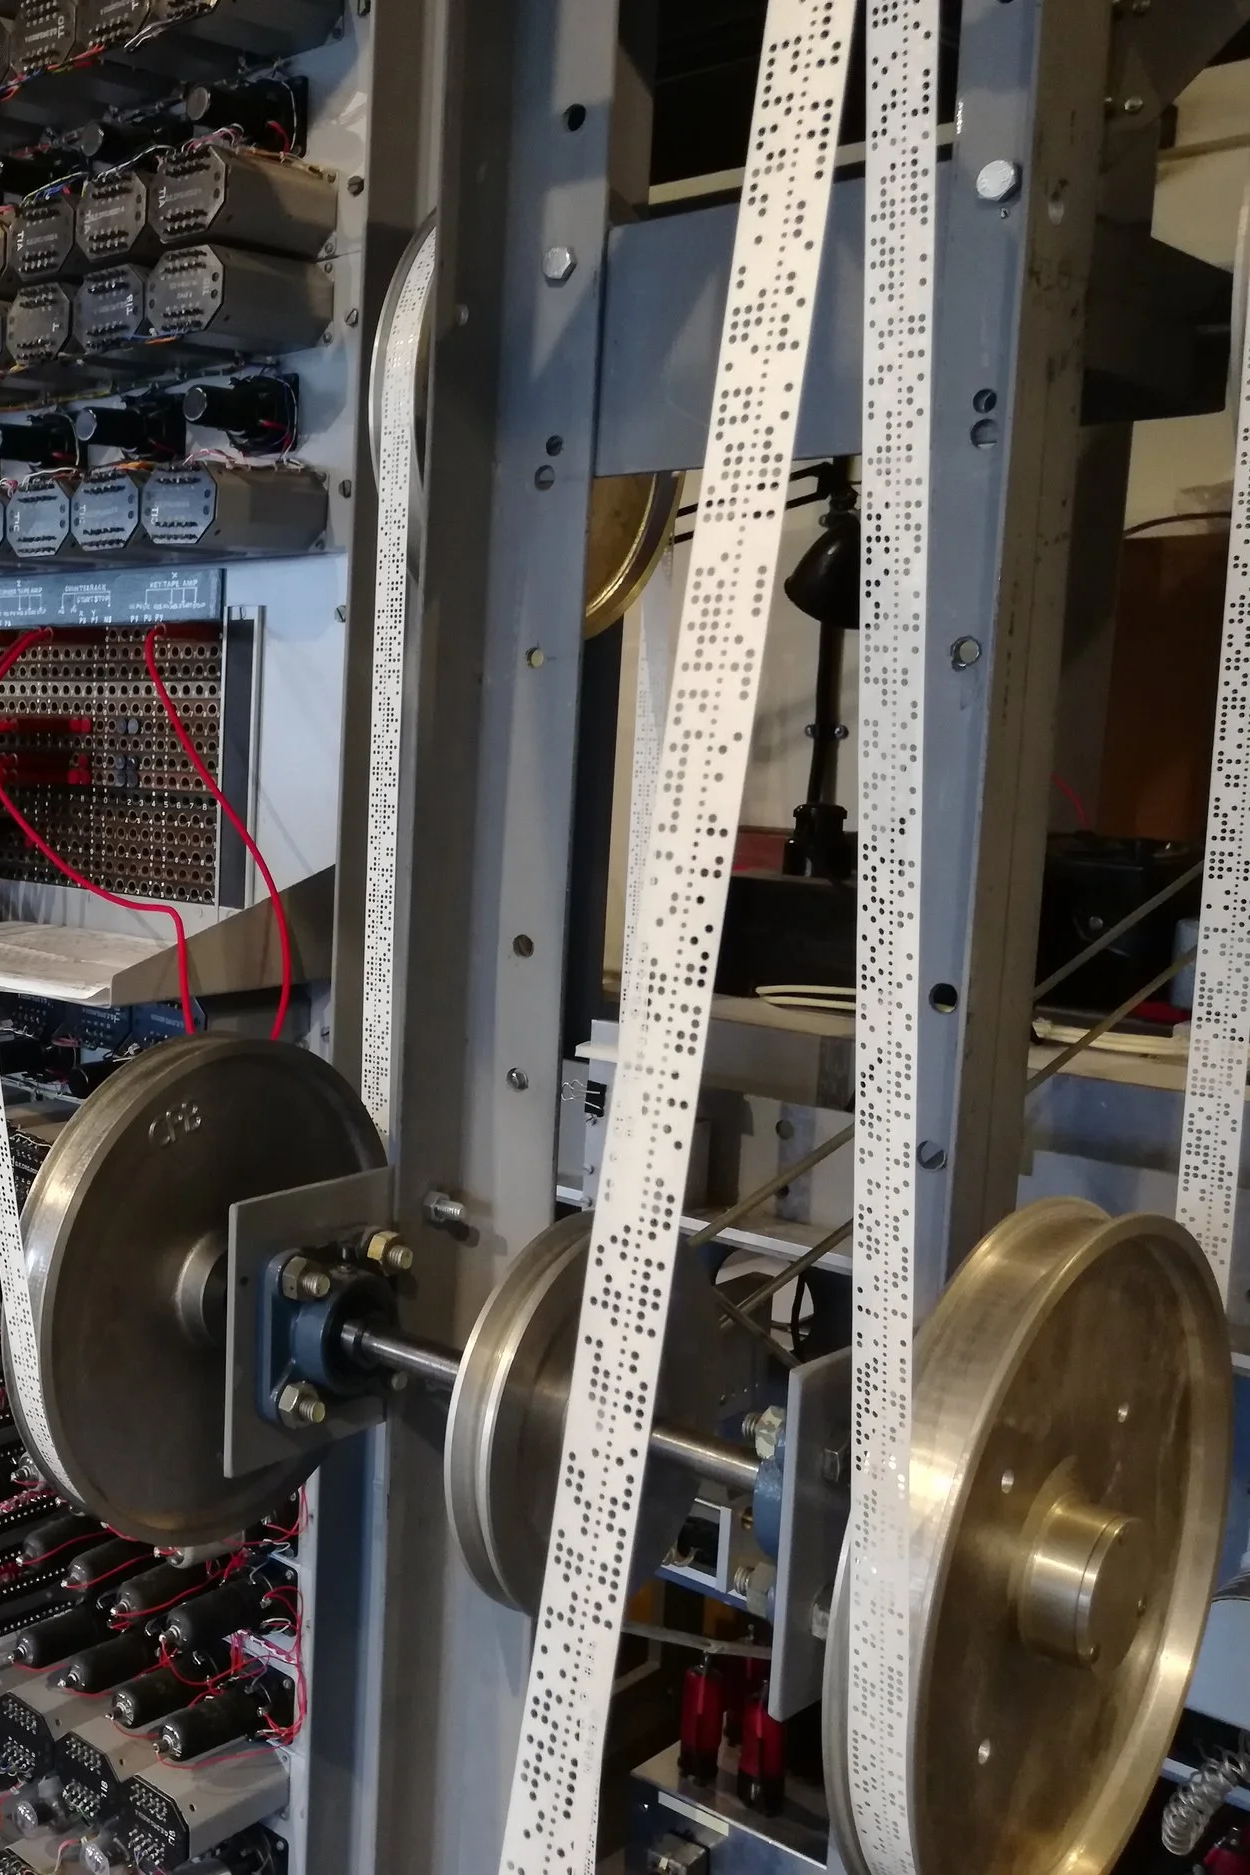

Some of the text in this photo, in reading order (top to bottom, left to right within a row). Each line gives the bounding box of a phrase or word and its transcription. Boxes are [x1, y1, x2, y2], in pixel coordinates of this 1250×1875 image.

[158, 186, 166, 208] TIA
[16, 230, 24, 251] TIA
[163, 580, 180, 588] TAPE
[100, 1780, 109, 1798] TIB
